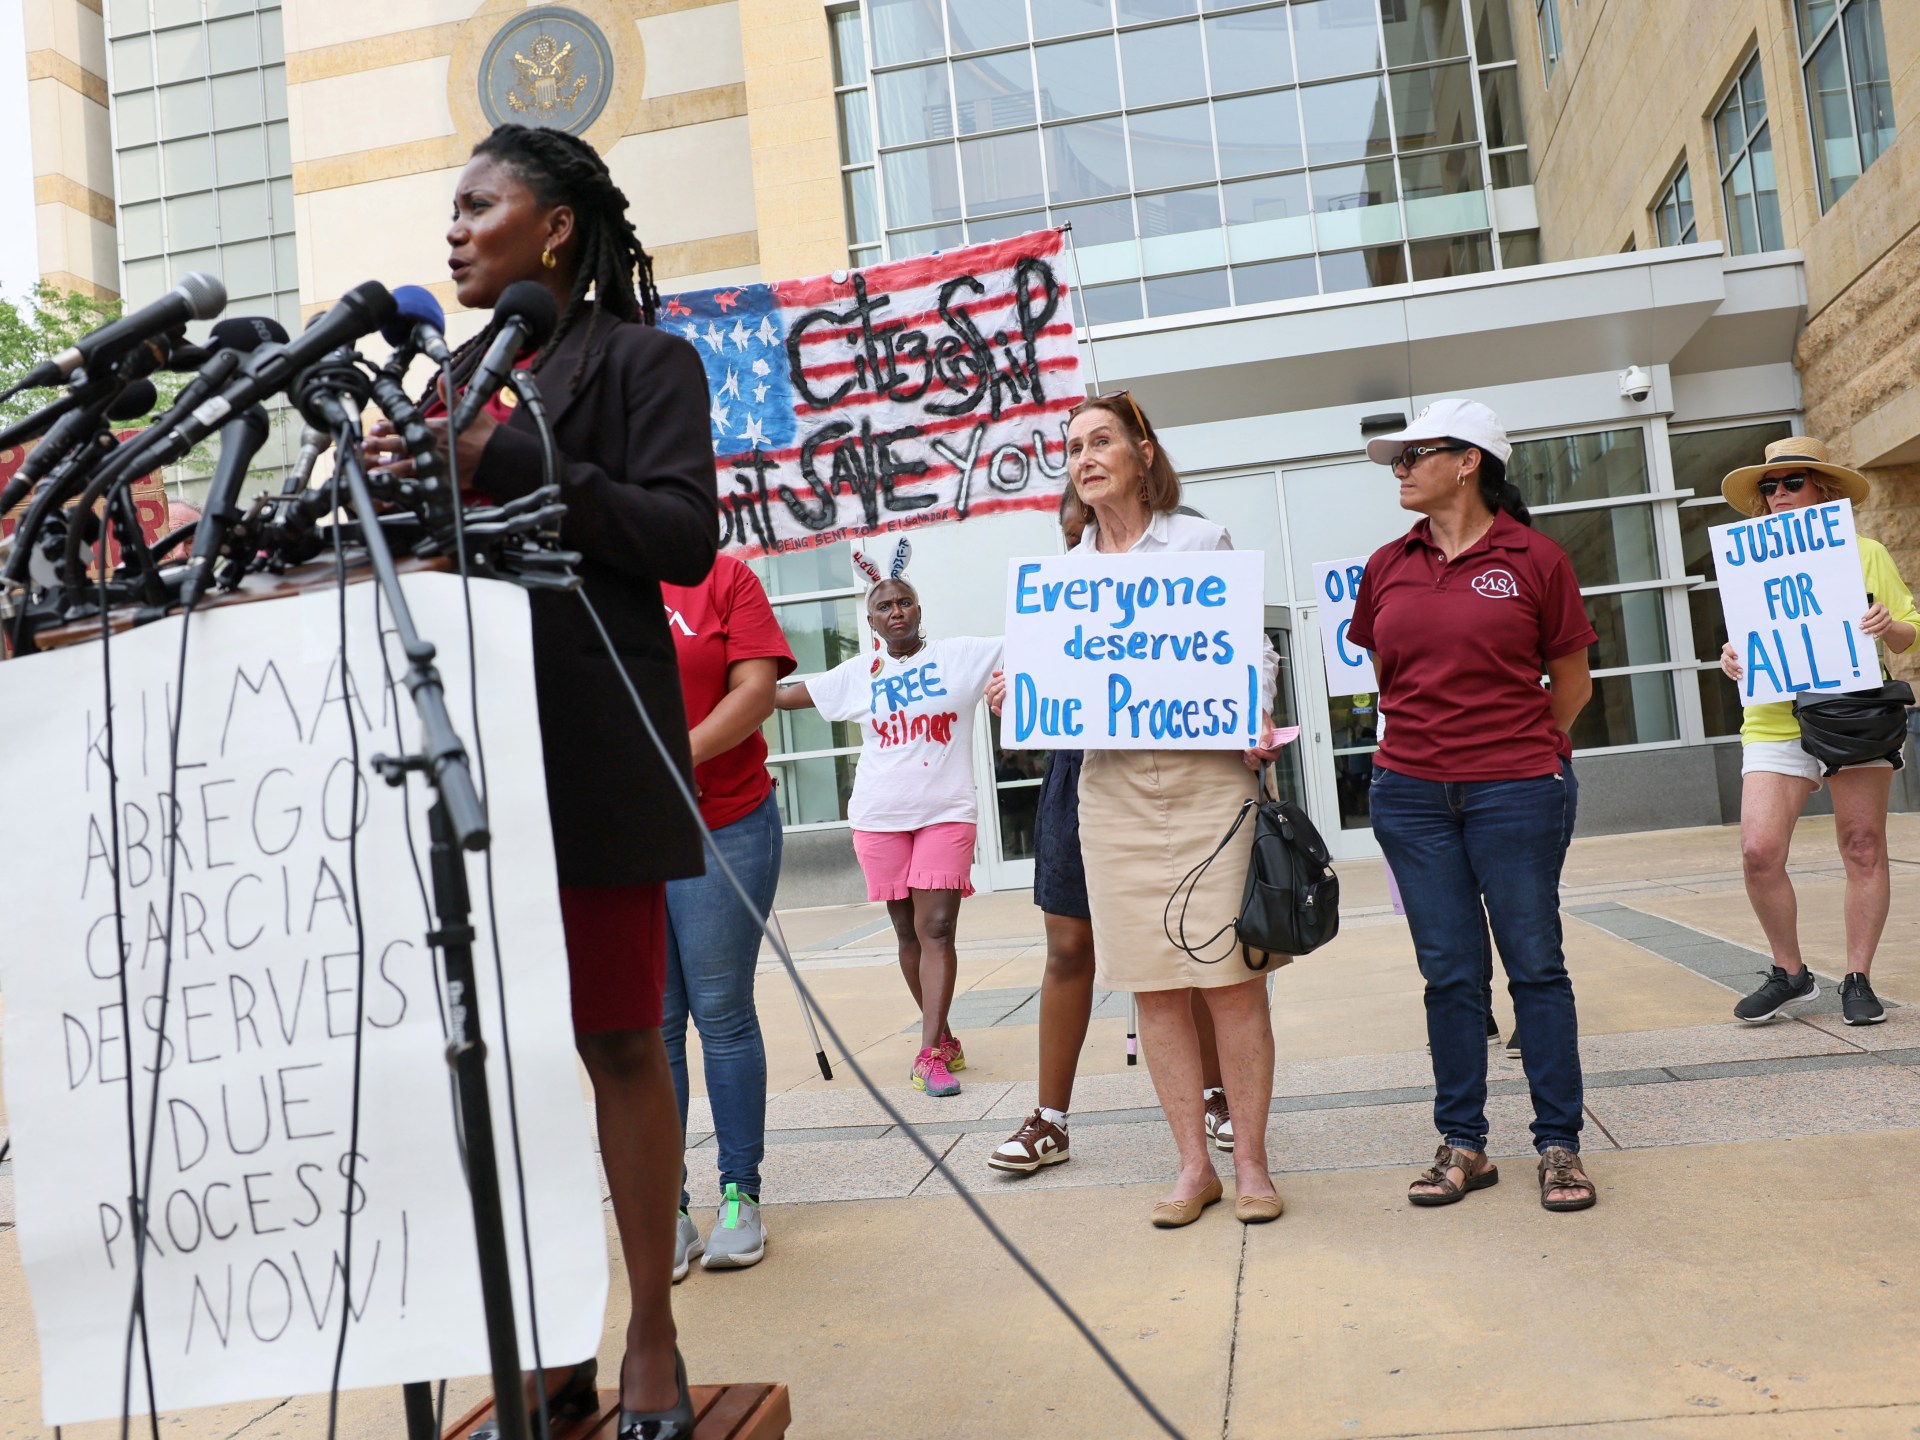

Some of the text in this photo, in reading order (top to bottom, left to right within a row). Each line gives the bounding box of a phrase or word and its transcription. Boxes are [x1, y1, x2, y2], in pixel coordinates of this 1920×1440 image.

[779, 417, 939, 530] SAVE
[931, 421, 1068, 519] YOU
[775, 537, 808, 552] BEING
[815, 526, 848, 546] SENT
[853, 525, 870, 538] TO
[1726, 505, 1846, 567] JUSTICE
[1016, 563, 1227, 629] Everyone
[1324, 565, 1364, 603] OB
[1471, 574, 1519, 597] CASA
[1764, 572, 1823, 621] FOR
[1064, 624, 1235, 665] deserves
[1747, 620, 1860, 698] ALL!
[870, 662, 947, 714] FREE
[1015, 664, 1259, 748] Due Process!
[81, 757, 369, 900] ABREGO
[87, 856, 353, 979] GARCIA
[63, 939, 415, 1090] DESERVES
[168, 1063, 335, 1172] DUE
[99, 1151, 369, 1270] PROCESS
[185, 1210, 409, 1355] NOW!
